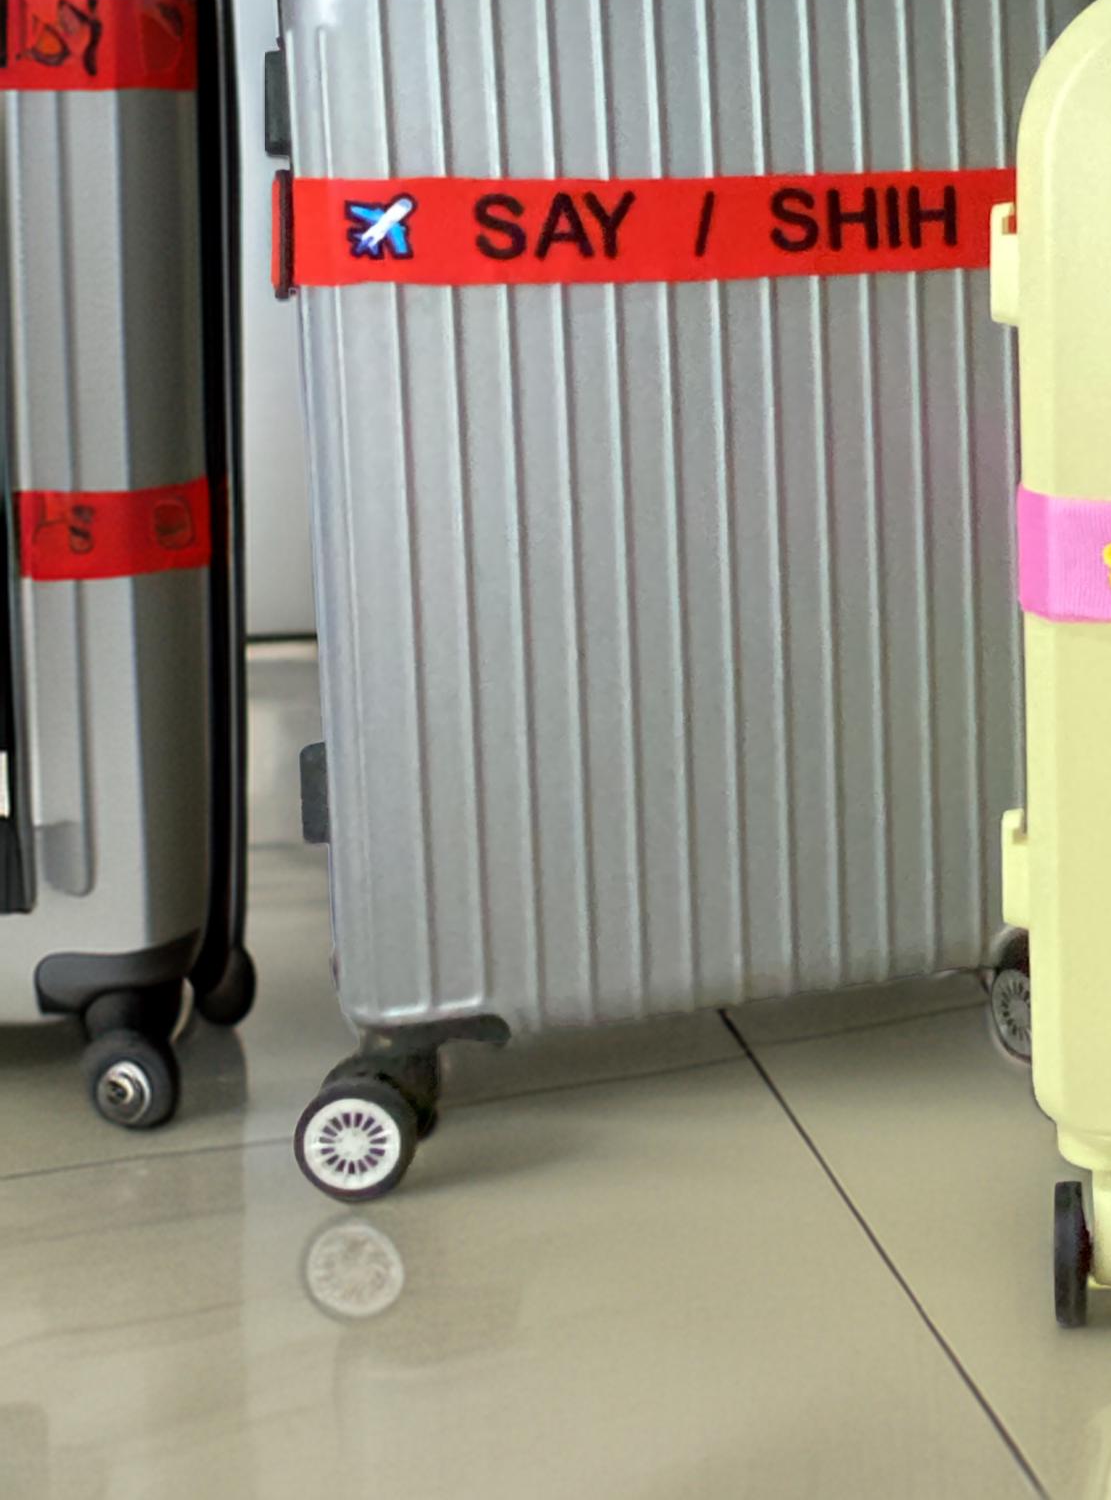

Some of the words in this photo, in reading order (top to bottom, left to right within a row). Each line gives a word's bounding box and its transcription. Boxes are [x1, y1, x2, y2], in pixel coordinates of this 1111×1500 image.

[474, 190, 637, 260] SAY
[694, 190, 715, 257] /
[769, 184, 959, 254] SHIH
